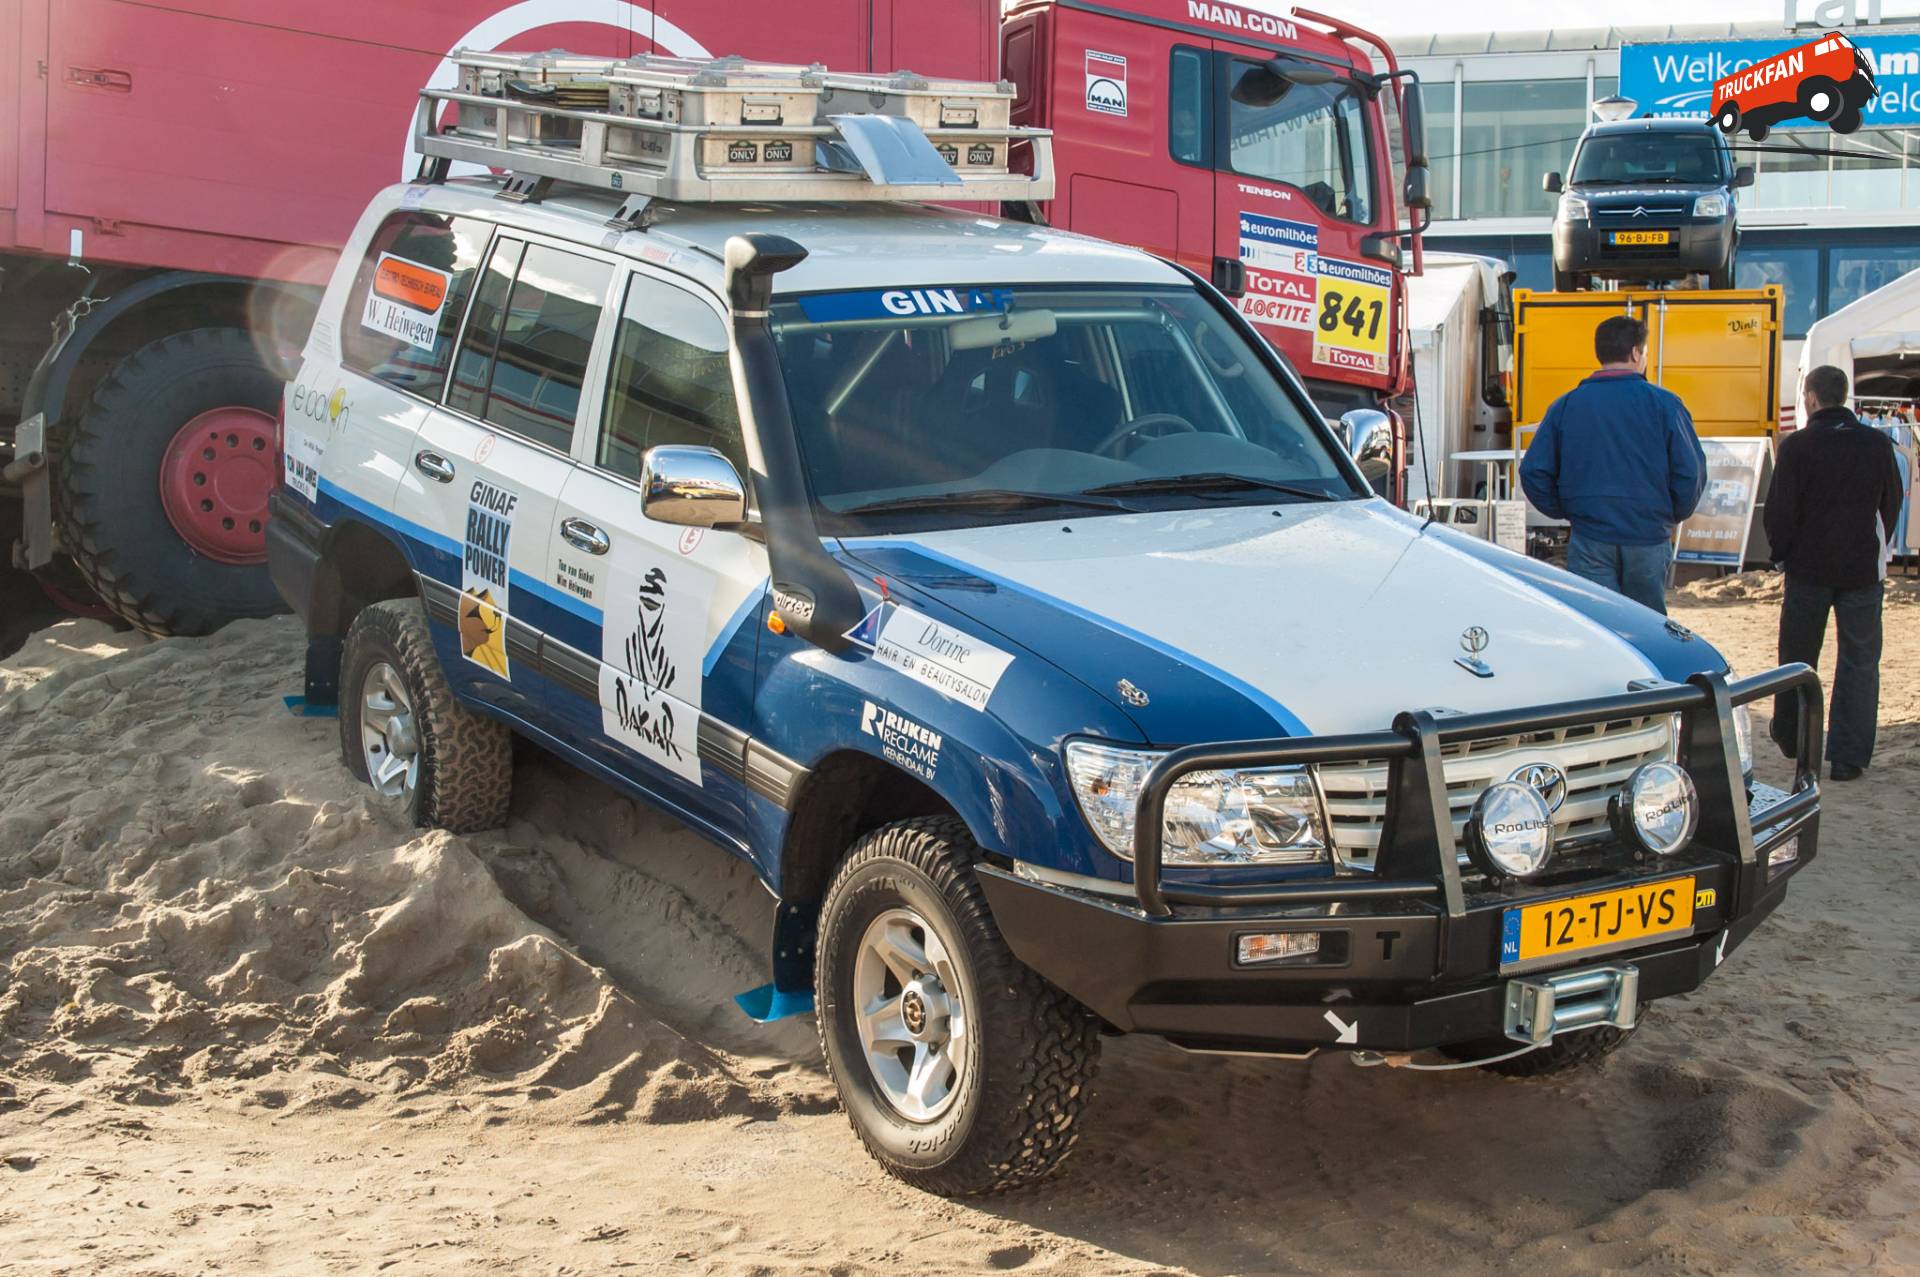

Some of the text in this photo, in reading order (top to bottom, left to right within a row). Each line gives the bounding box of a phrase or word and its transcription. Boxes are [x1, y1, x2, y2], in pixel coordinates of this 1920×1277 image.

[1188, 0, 1298, 40] MAN.COM
[1091, 94, 1122, 107] MAN
[730, 151, 755, 160] ONLY
[766, 150, 790, 159] ONLY
[970, 153, 992, 162] ONLY
[1237, 184, 1291, 200] TENSON
[1251, 222, 1318, 245] euromilhões
[1297, 257, 1305, 272] 2
[1328, 265, 1391, 286] euromilhões
[1246, 271, 1311, 298] TOTAL
[369, 298, 434, 345] W. Heiwegen
[1243, 298, 1311, 323] LOCTITE
[1319, 291, 1383, 340] 841
[1331, 349, 1374, 368] TOTAL
[470, 481, 518, 517] GINAF
[467, 508, 511, 557] RALLY
[465, 545, 506, 588] POWER
[918, 621, 971, 664] Dorine
[877, 643, 989, 705] HAIR EN BEAUTYSALON
[886, 708, 942, 751] RIJKEN
[884, 728, 939, 768] RECLAME
[1544, 889, 1676, 948] 12-TJ-VS
[1503, 942, 1518, 954] NL
